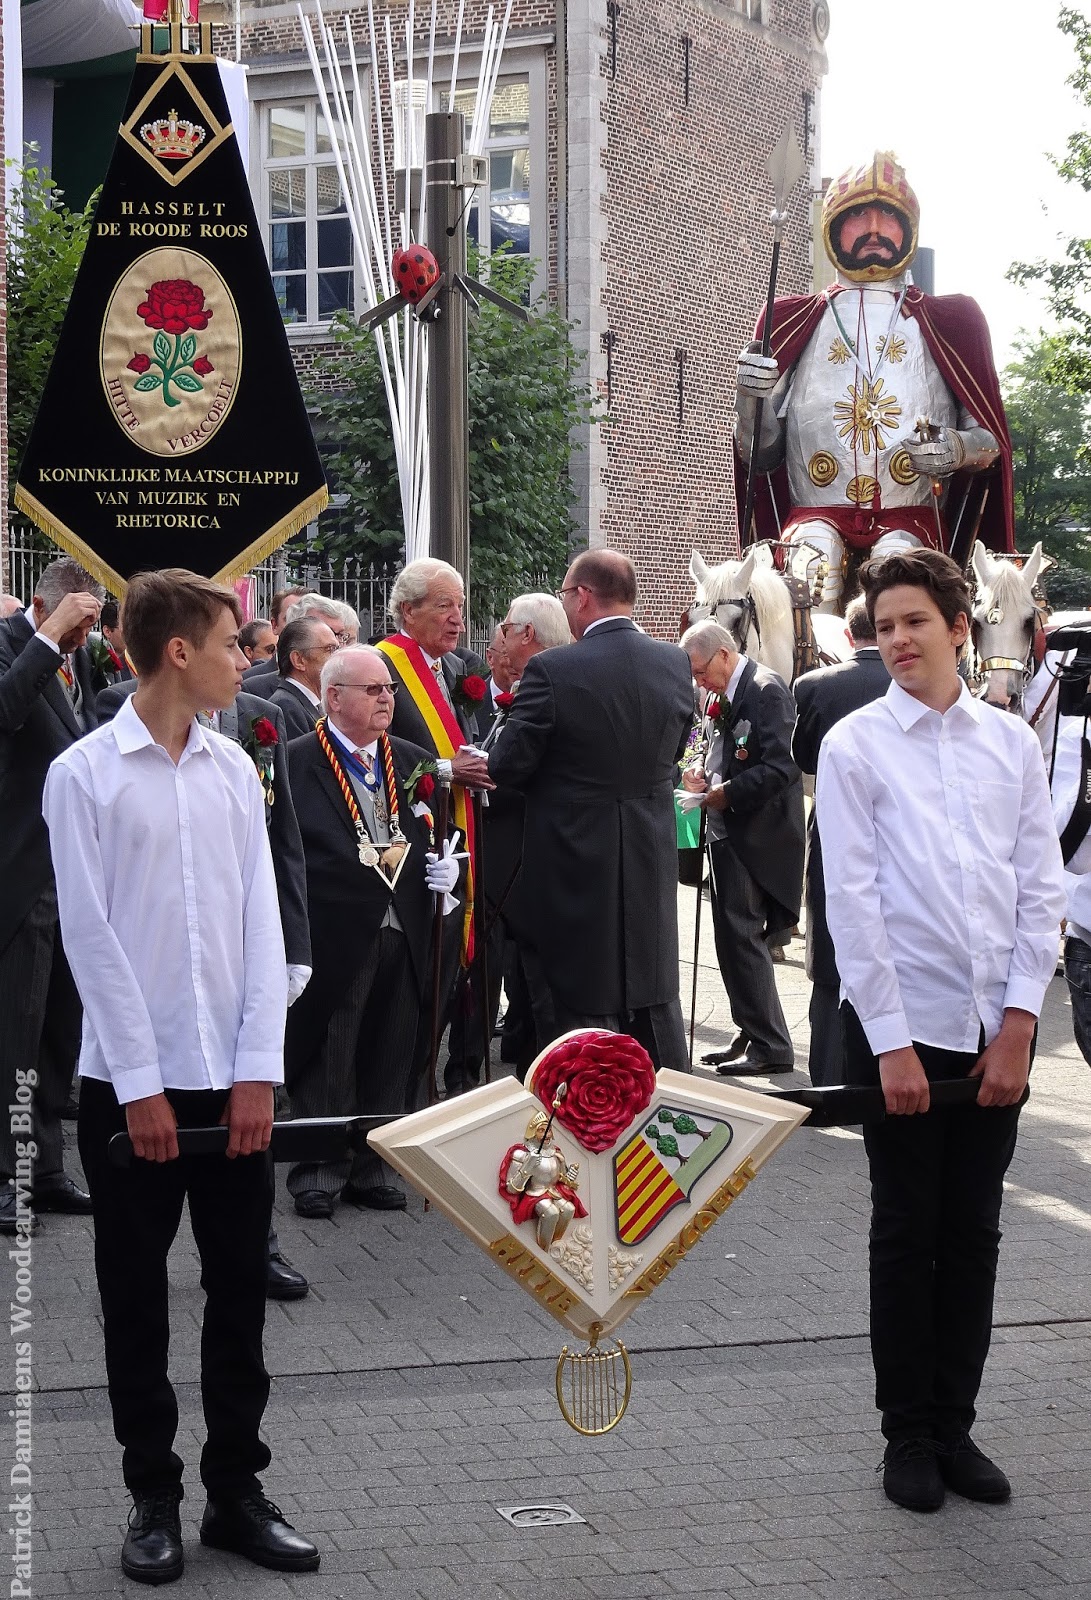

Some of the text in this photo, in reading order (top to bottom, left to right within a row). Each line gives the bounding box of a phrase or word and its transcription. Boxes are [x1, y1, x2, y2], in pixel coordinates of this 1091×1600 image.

[120, 201, 226, 217] HASSELT
[96, 222, 248, 238] DE ROODE ROOS
[108, 377, 233, 452] HITTE VERCOELT
[38, 468, 300, 486] KONINKLIJKE MAATSCHAPPIJ
[95, 491, 241, 507] VAN MUZIEK EN
[115, 514, 222, 529] RHETORICA
[621, 1155, 757, 1297] VERCOELT
